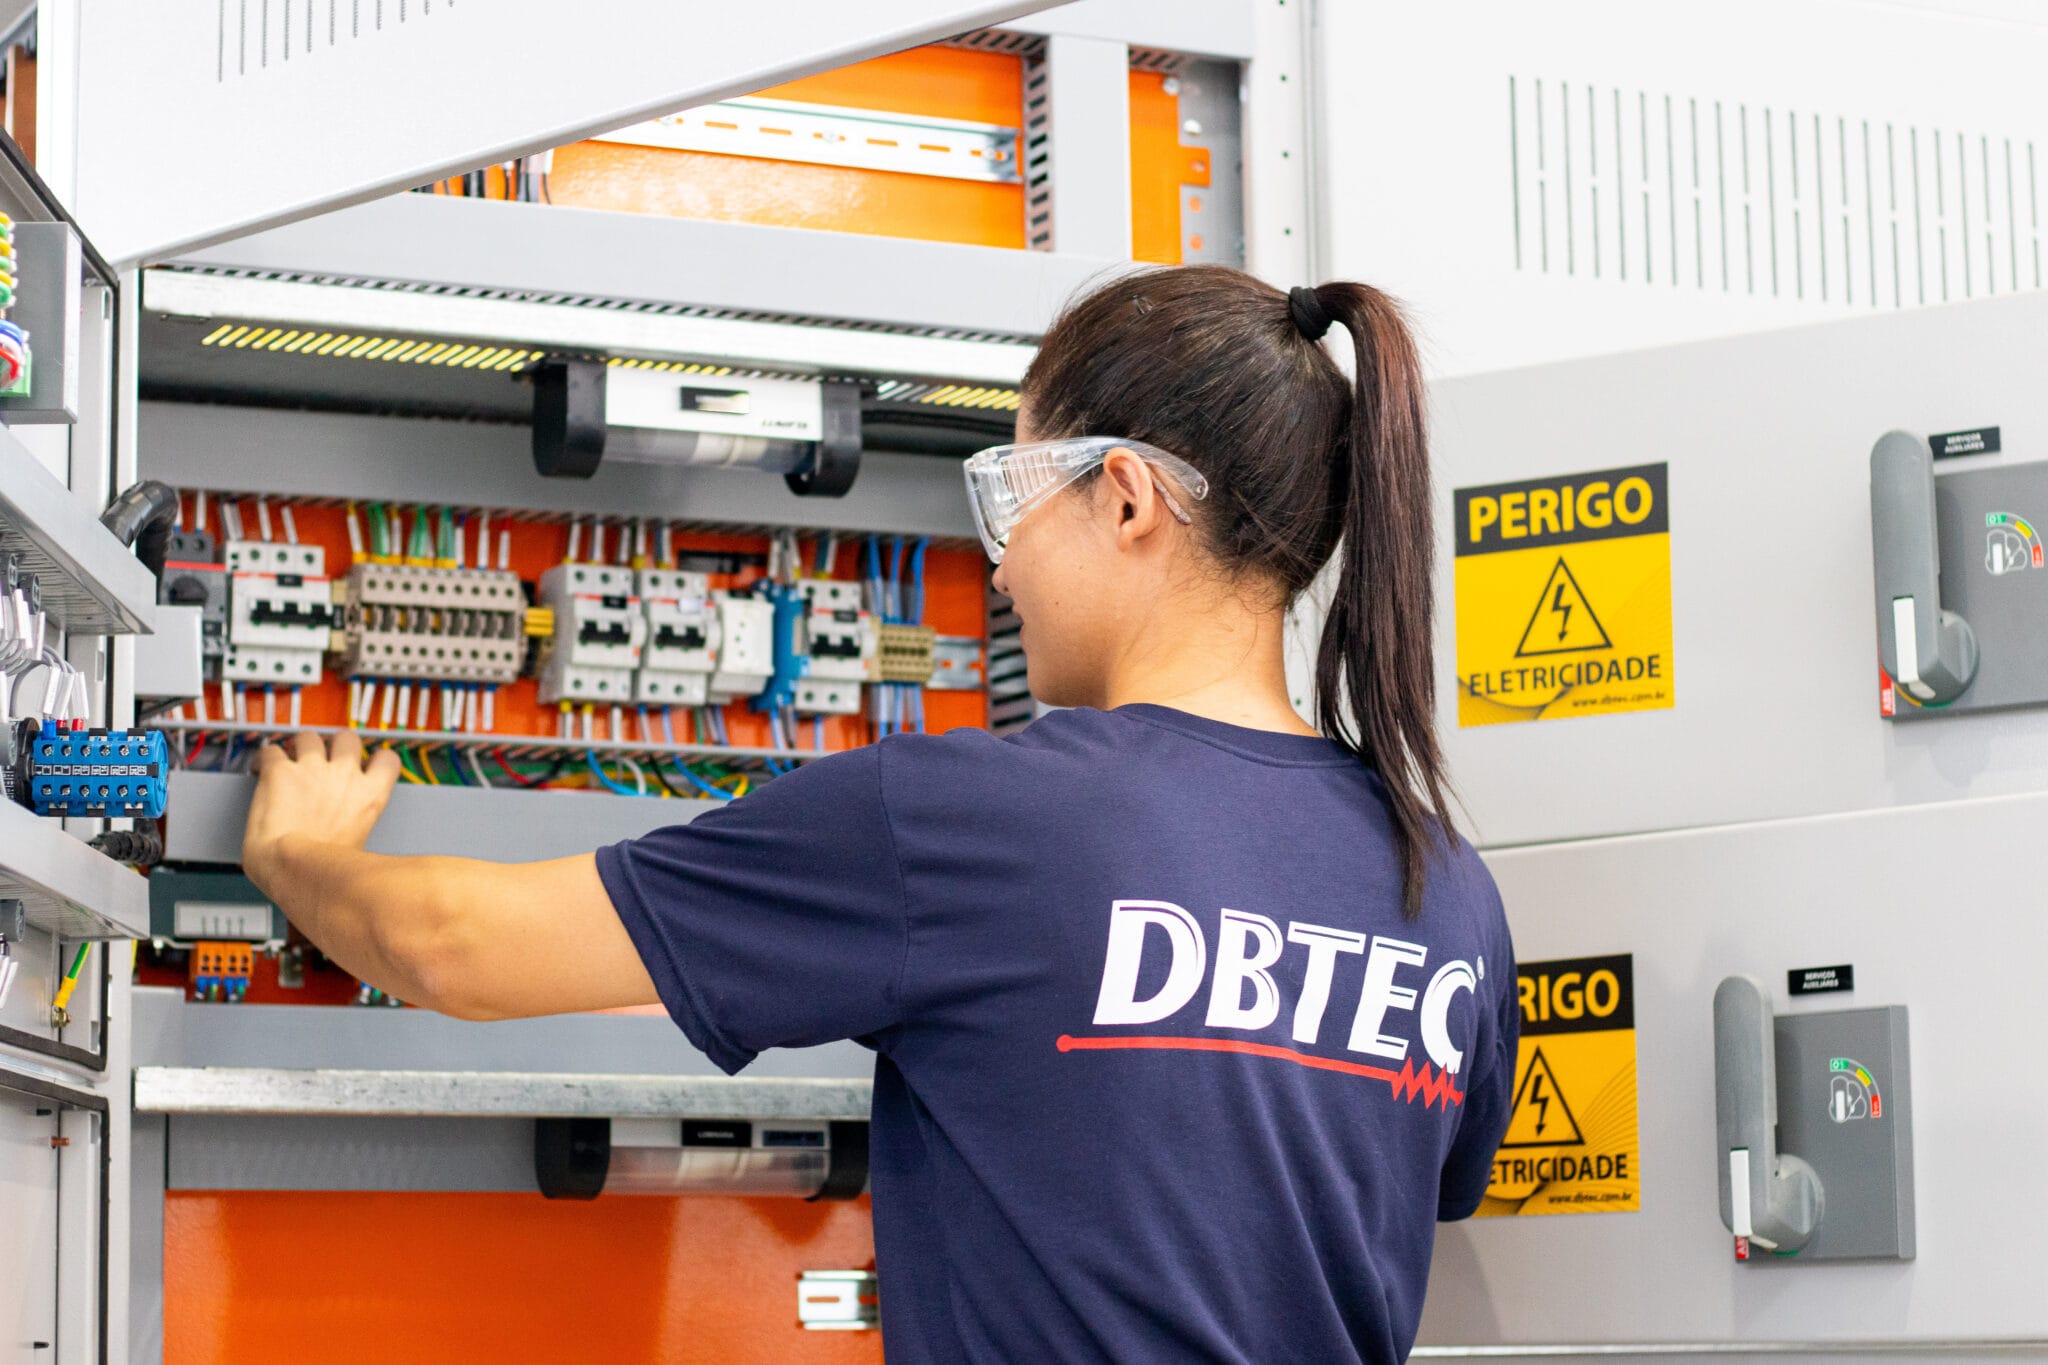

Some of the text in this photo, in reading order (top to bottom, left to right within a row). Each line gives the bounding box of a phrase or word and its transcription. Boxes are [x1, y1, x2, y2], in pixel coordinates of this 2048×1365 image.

[1469, 476, 1653, 543] PERIGO
[1469, 654, 1661, 697] ELETRICIDADE
[1092, 900, 1477, 1074] DBTEC
[1517, 969, 1619, 1022] RIGO
